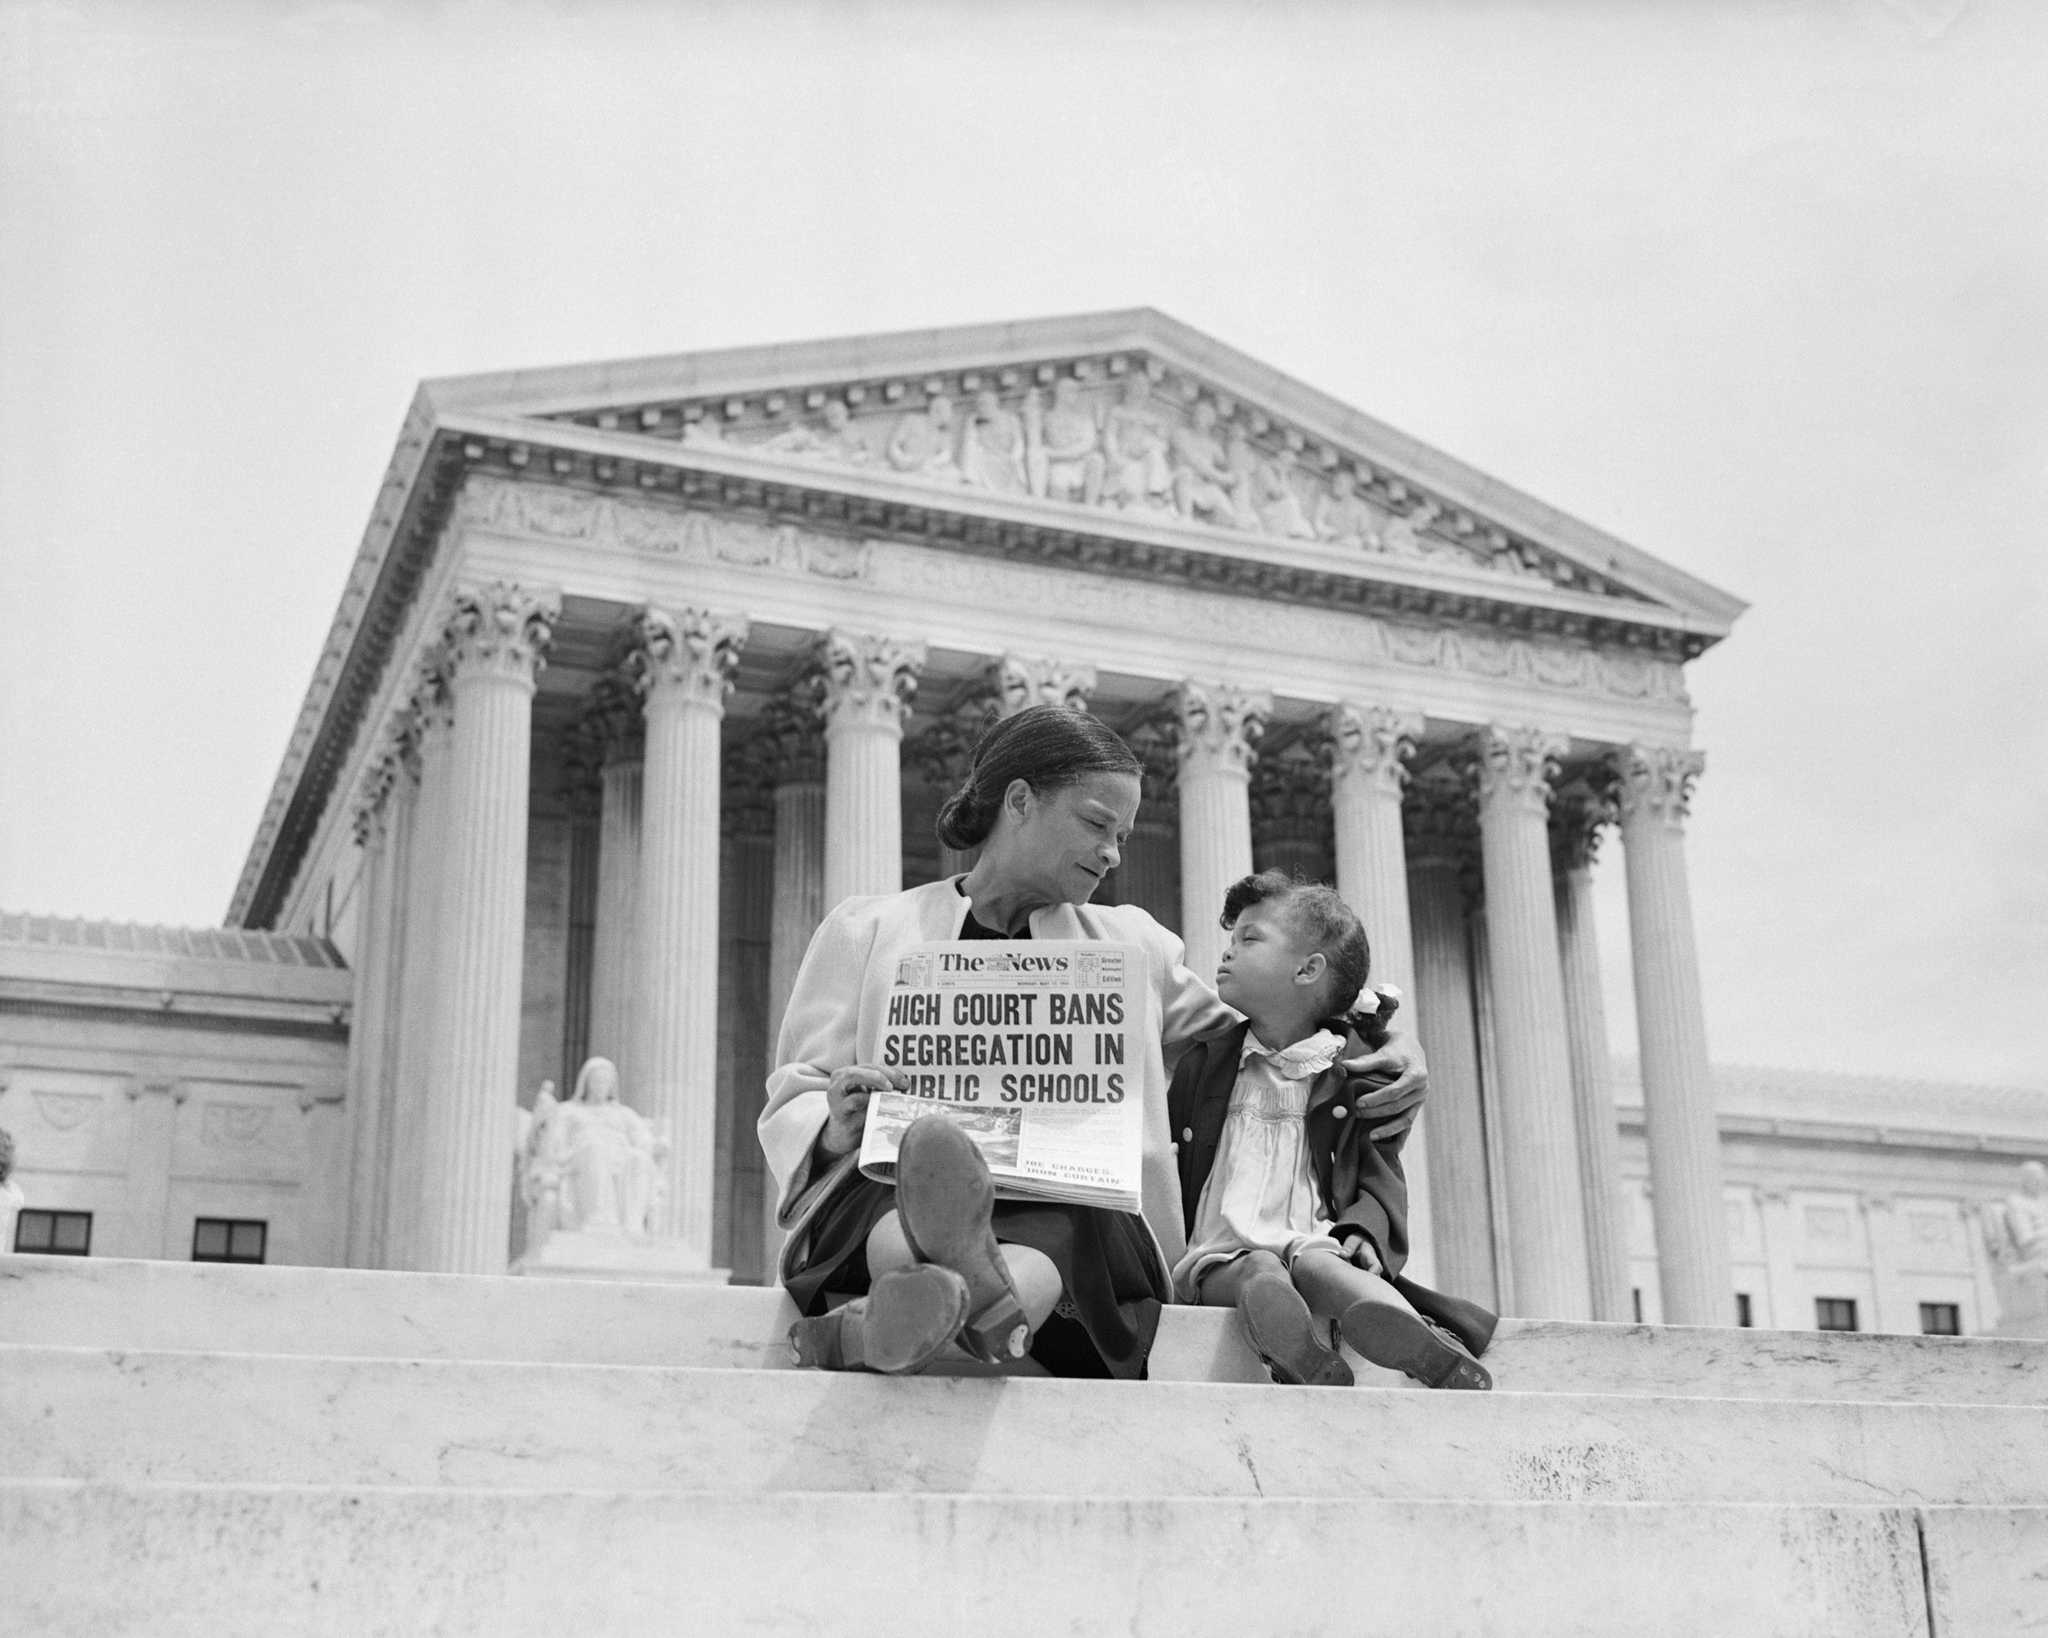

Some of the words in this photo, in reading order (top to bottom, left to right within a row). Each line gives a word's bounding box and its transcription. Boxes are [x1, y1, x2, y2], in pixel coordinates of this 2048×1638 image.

[940, 953, 985, 971] The
[1005, 953, 1069, 971] News
[888, 994, 941, 1026] HIGH
[954, 994, 1037, 1026] COURT
[1050, 993, 1125, 1026] BANS
[884, 1034, 1073, 1067] SEGREGATION
[1095, 1033, 1124, 1065] IN
[904, 1074, 980, 1102] BLIC
[1000, 1073, 1125, 1103] SCHOOLS
